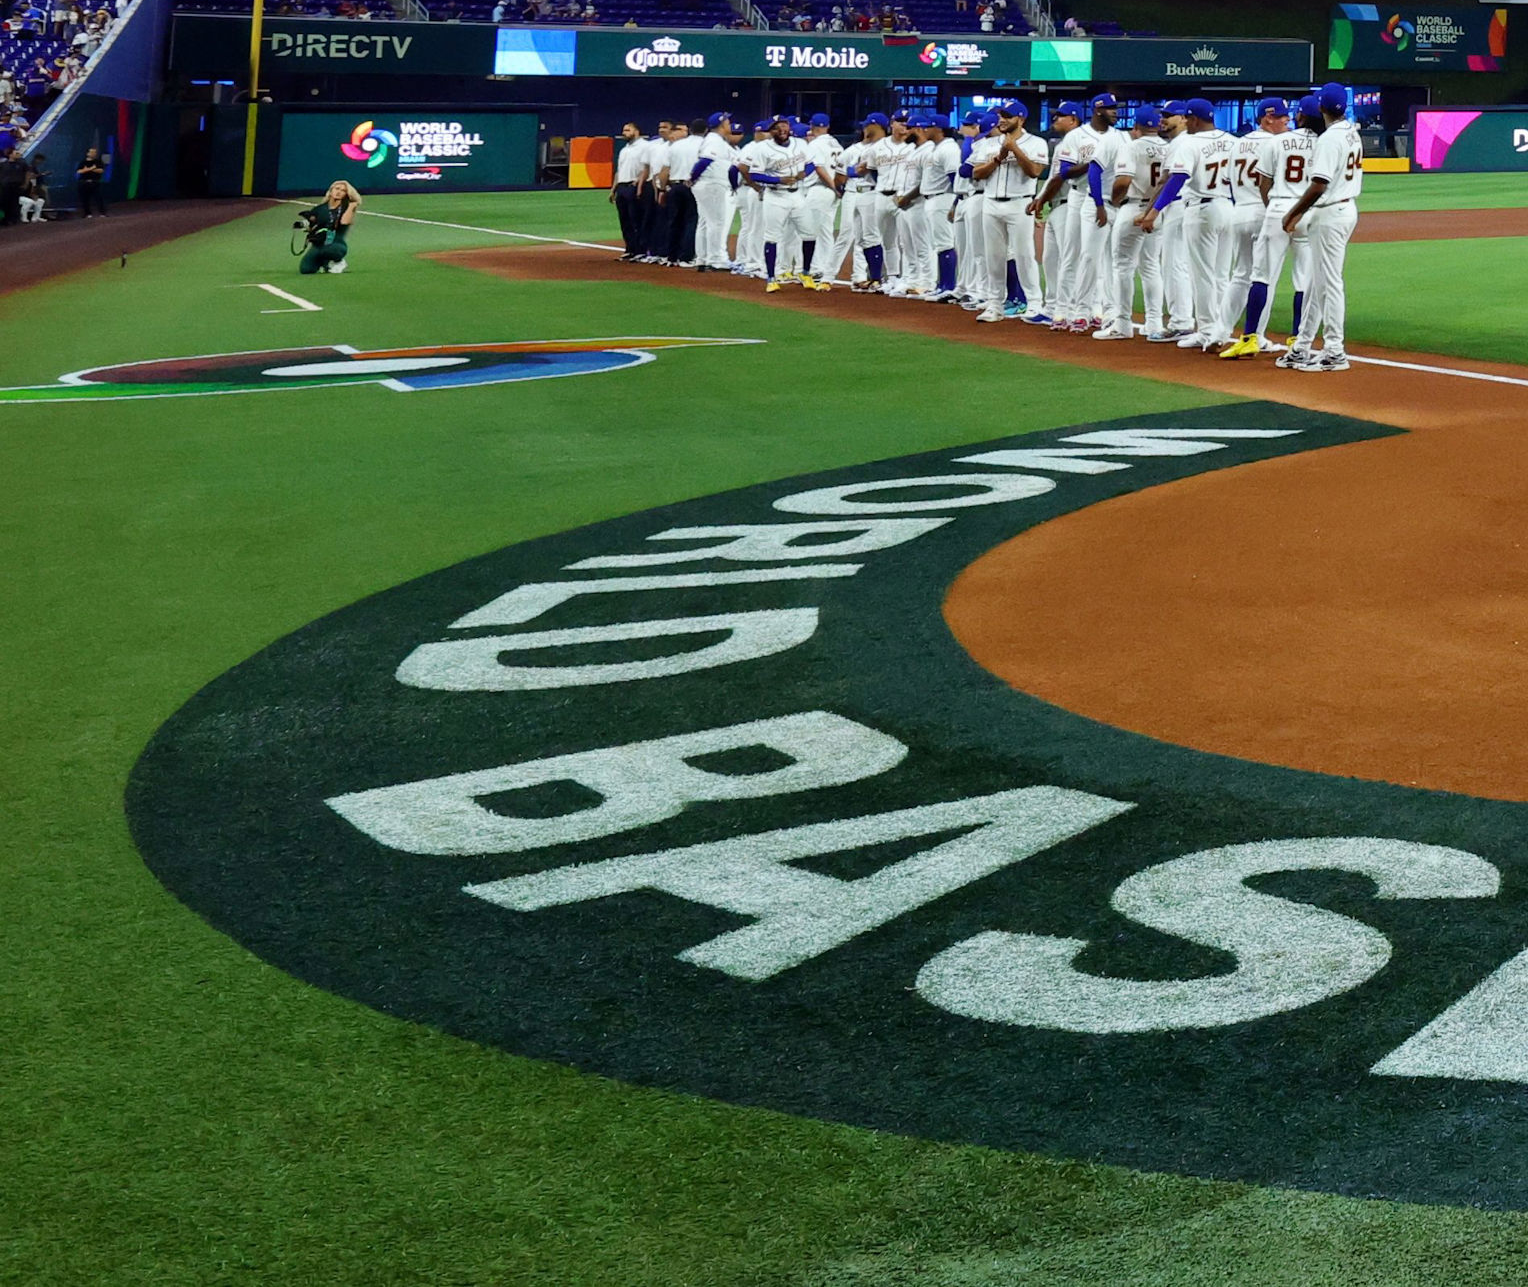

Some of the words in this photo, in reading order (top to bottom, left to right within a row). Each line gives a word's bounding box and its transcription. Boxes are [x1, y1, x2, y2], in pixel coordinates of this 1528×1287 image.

[1416, 16, 1452, 26] WORLD
[1416, 25, 1465, 36] BASEBALL
[1415, 34, 1457, 44] CLASSIC
[271, 32, 413, 60] DIRECTV
[946, 43, 978, 51] WORLD
[625, 47, 705, 73] Corona
[765, 45, 786, 67] T
[790, 47, 869, 69] Mobile
[1166, 62, 1241, 77] Budweiser
[400, 122, 463, 134] WORLD
[399, 133, 485, 145] BASEBALL
[1282, 138, 1312, 151] BAZA
[394, 428, 1303, 691] WORLD
